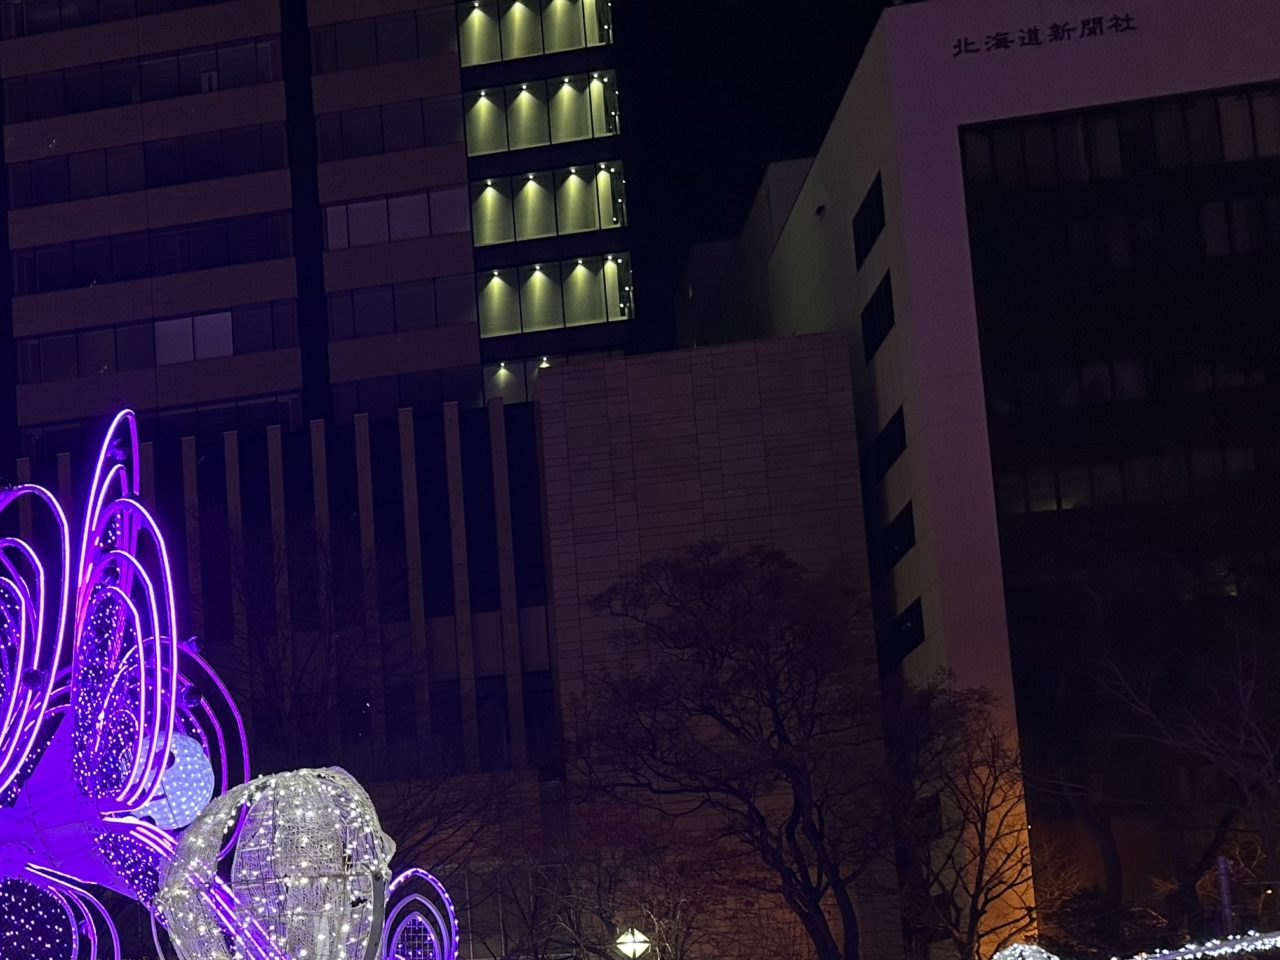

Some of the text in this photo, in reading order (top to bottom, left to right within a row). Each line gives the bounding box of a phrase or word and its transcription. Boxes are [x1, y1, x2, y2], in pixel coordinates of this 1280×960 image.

[953, 13, 1138, 57] 北海道新聞社
